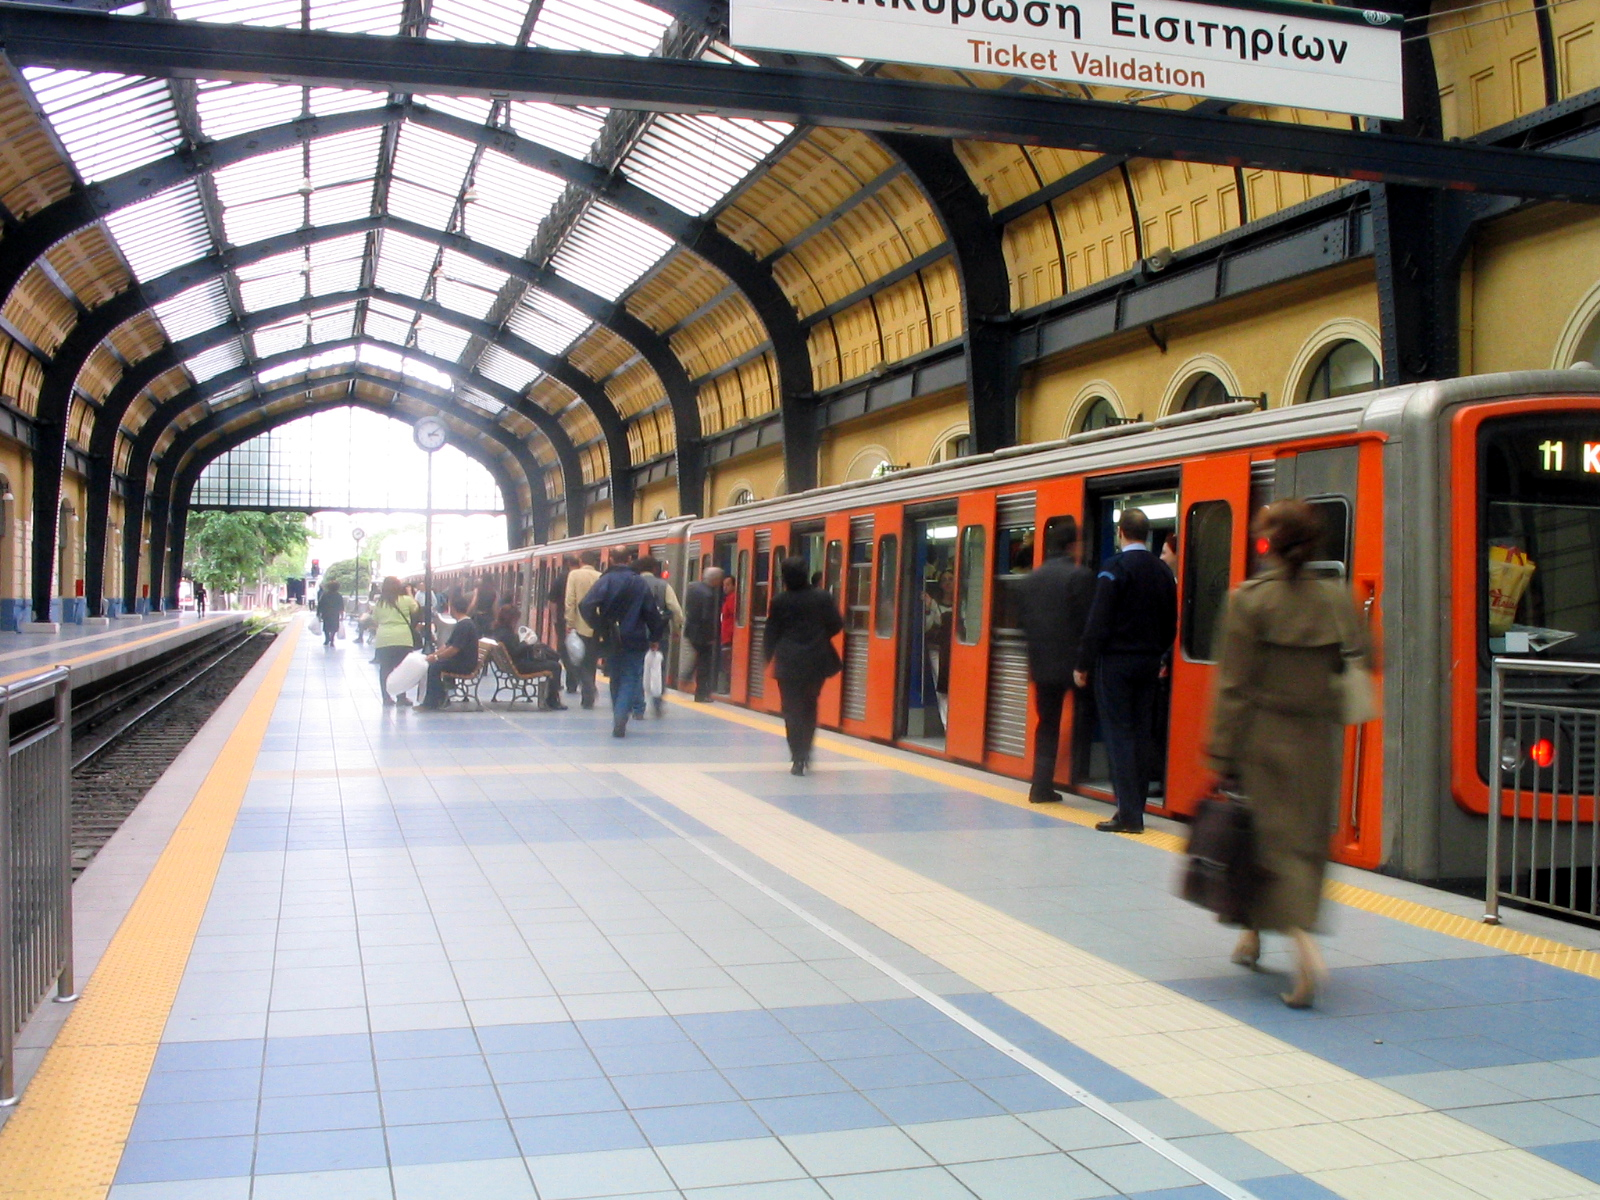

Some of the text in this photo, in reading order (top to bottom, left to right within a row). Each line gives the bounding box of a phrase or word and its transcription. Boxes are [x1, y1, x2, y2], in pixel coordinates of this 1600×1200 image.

[1110, 1, 1348, 64] Εισιτηρίων
[967, 39, 1206, 89] Ticket Validation
[1538, 440, 1563, 471] 11
